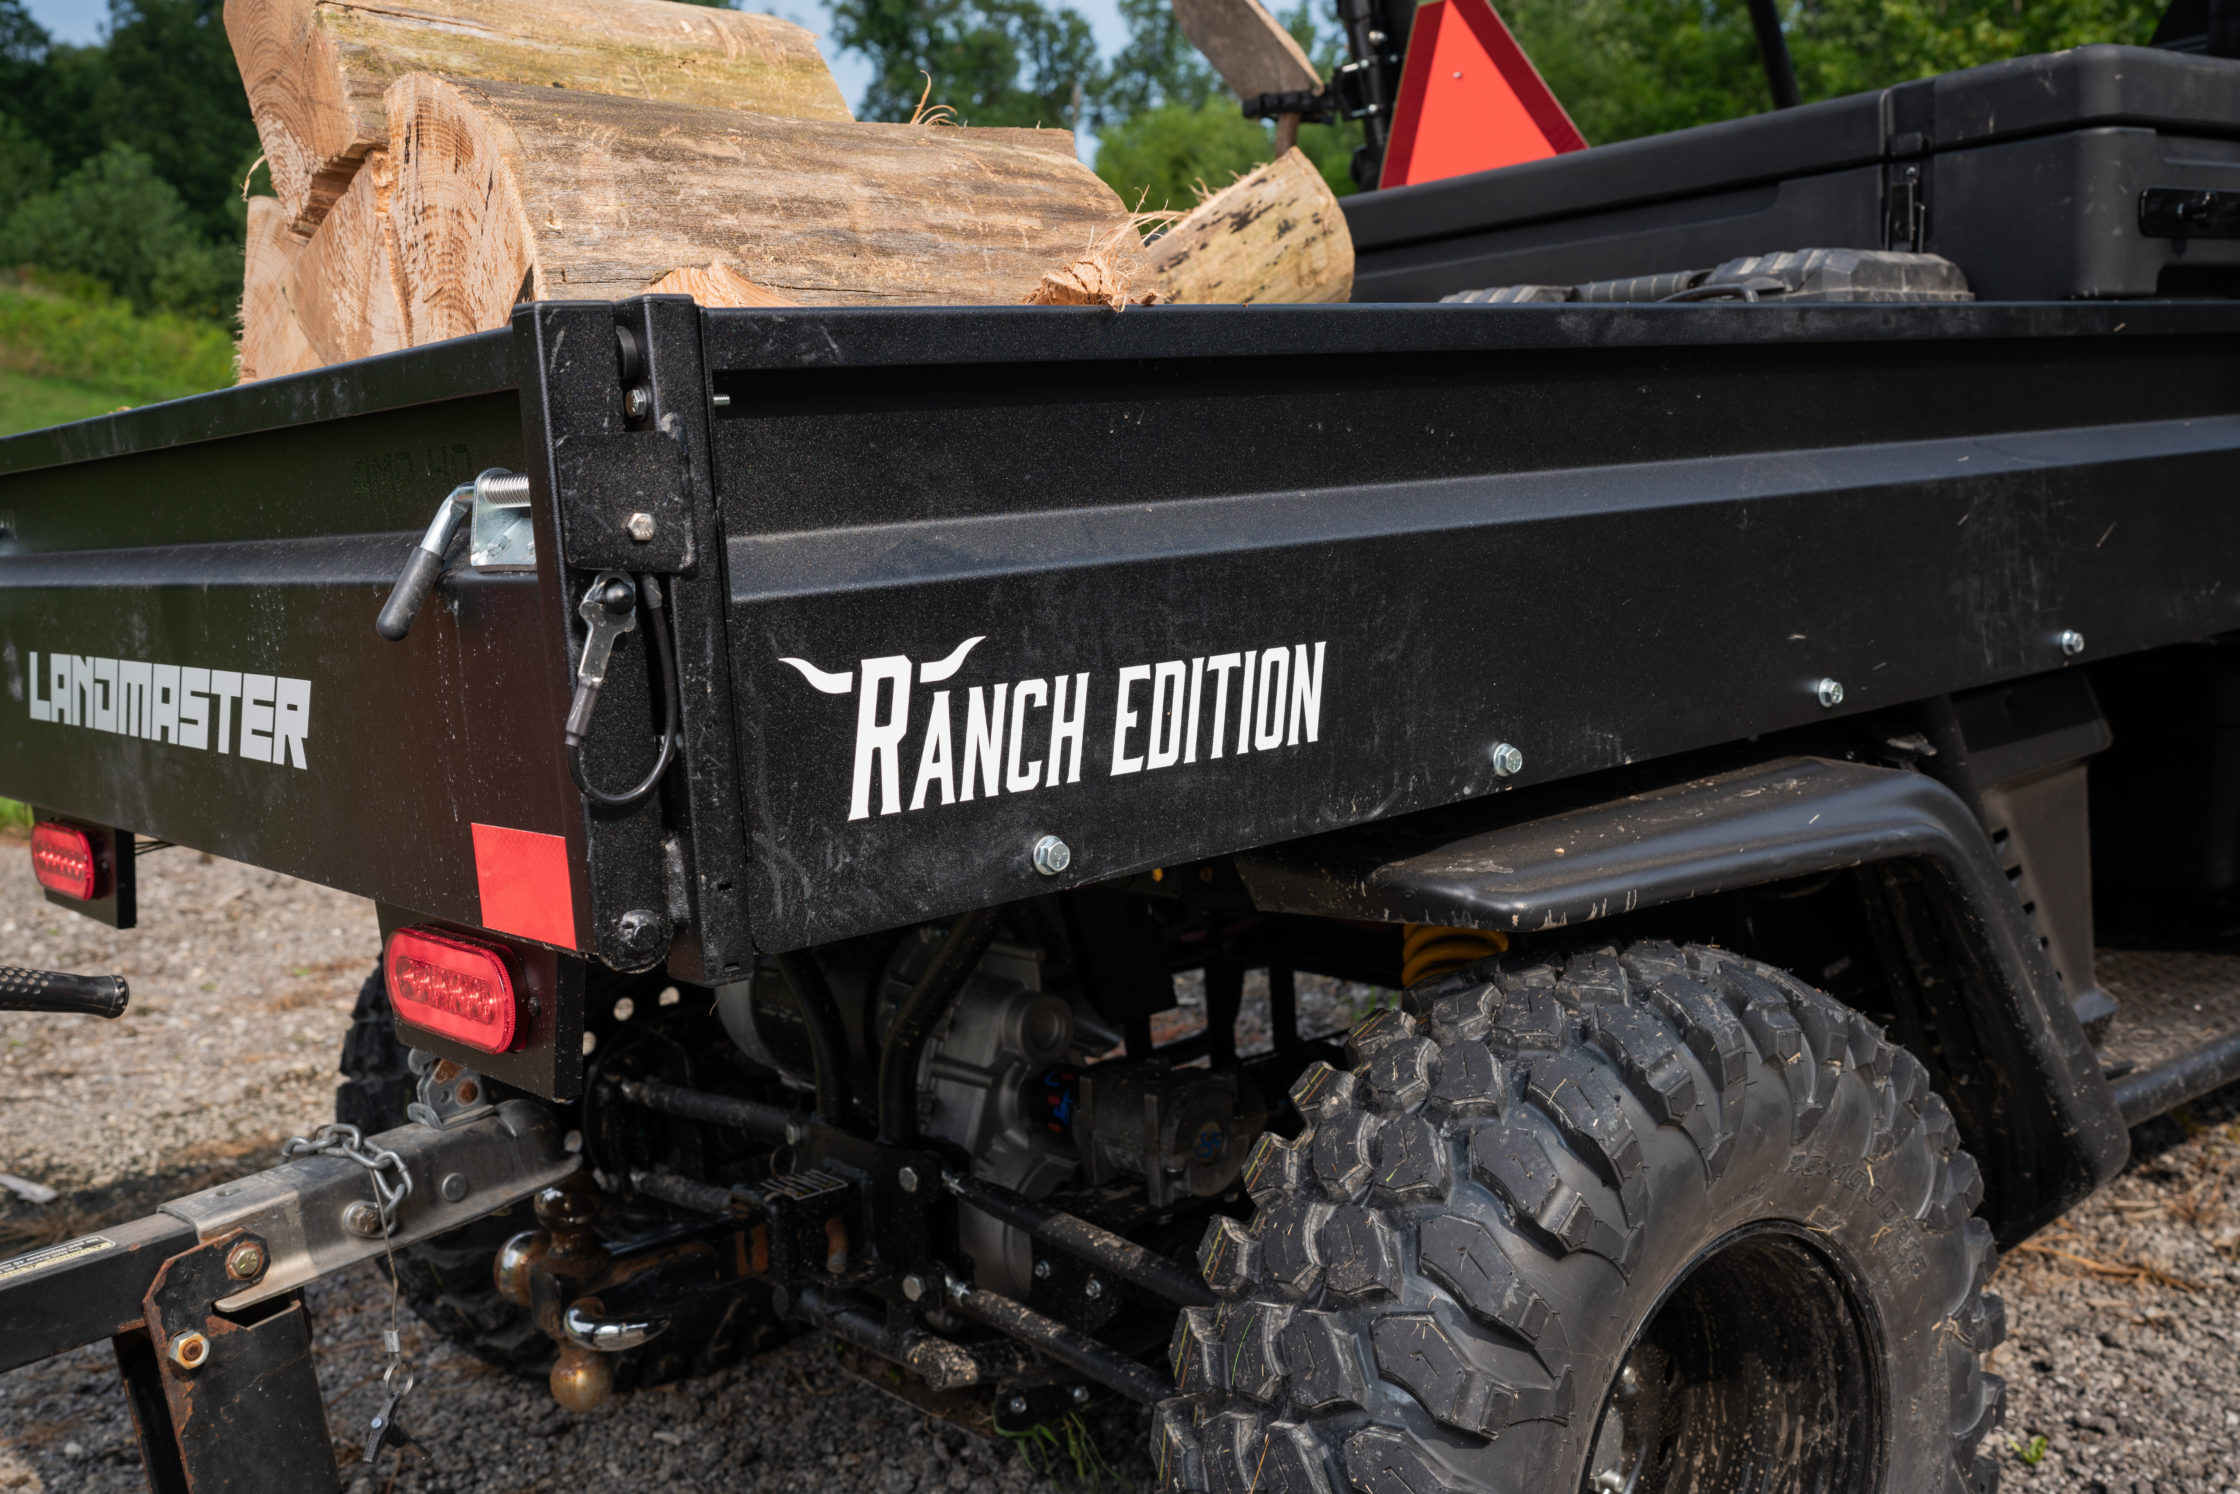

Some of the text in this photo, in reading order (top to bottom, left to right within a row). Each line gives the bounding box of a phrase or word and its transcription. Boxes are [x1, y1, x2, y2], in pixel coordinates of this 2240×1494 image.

[29, 651, 312, 770] LANDMASTER
[847, 640, 1327, 822] RANCH EDITION
